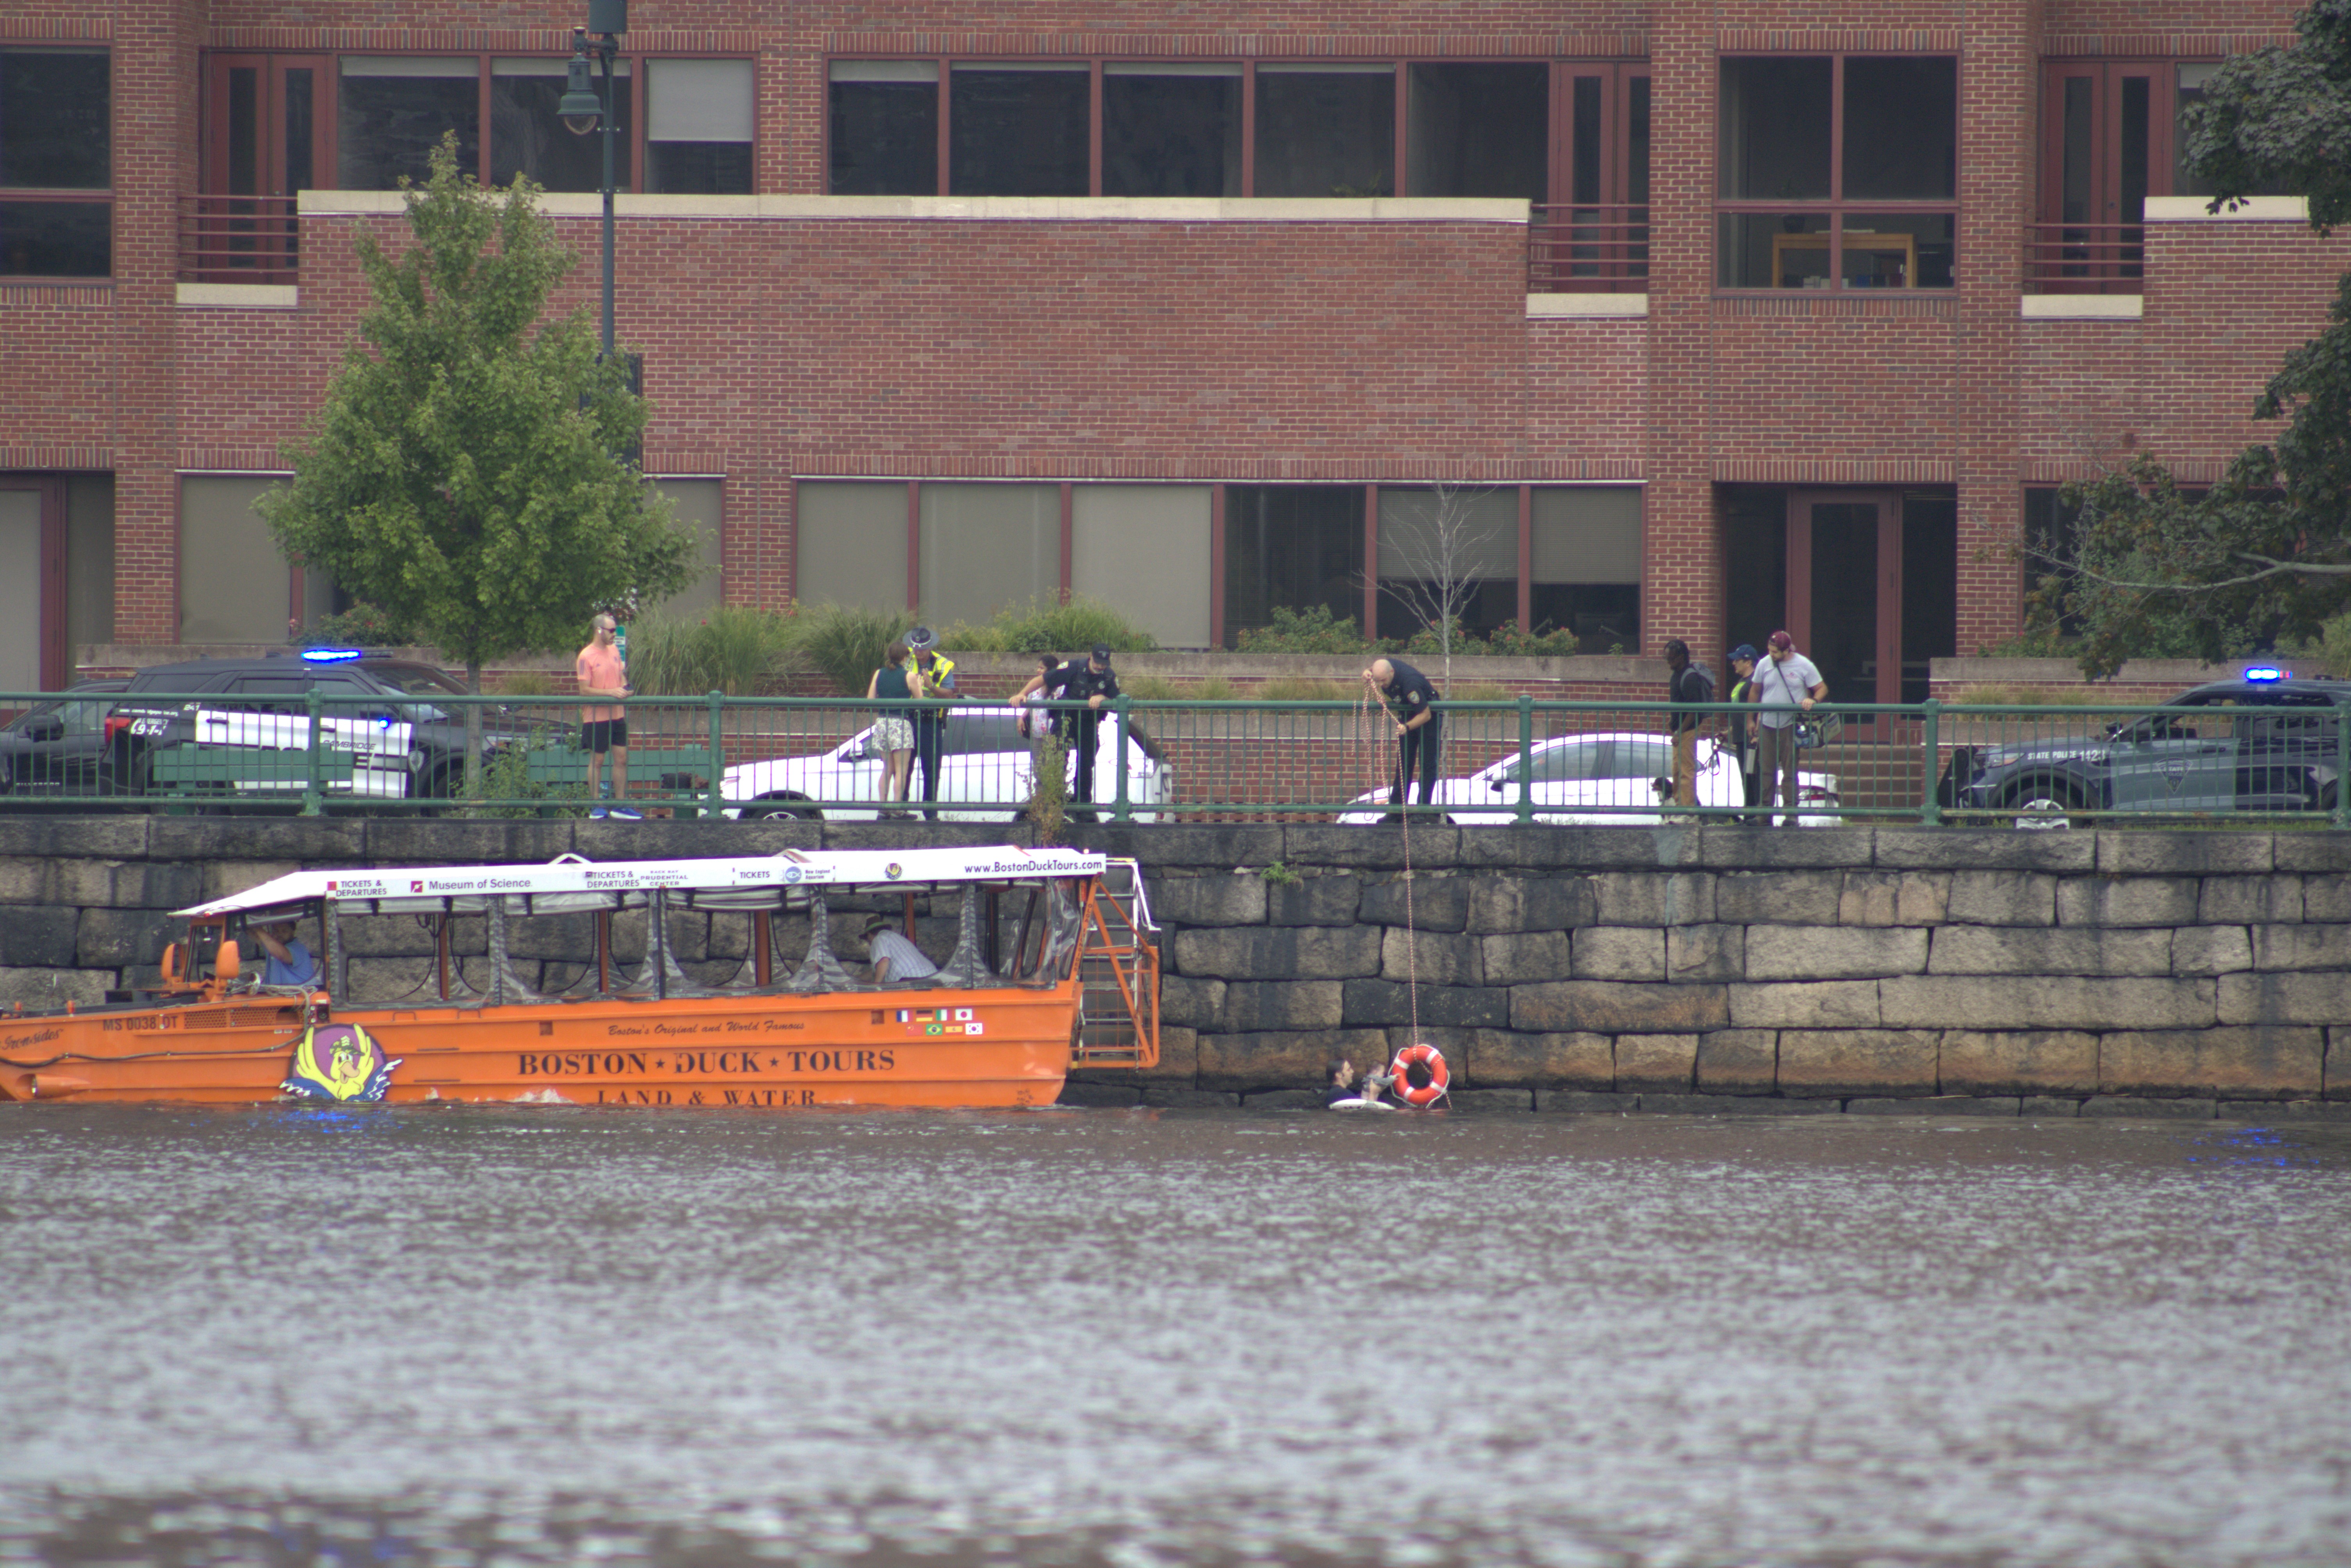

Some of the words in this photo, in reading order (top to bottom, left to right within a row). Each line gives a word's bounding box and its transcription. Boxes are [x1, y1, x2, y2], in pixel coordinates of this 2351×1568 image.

[2028, 751, 2050, 760] STATE
[965, 860, 1102, 872] www.BostonDuckTours.com
[430, 881, 473, 890] Museum
[478, 879, 487, 888] of
[587, 880, 640, 888] DEPARTURES
[336, 888, 387, 897] DEPARTURES
[103, 1019, 122, 1031] MS
[127, 1017, 157, 1030] 0038
[162, 1015, 178, 1029] DT
[608, 1024, 649, 1035] Boston's
[654, 1023, 698, 1036] Original
[701, 1024, 722, 1033] and
[726, 1021, 760, 1031] World
[763, 1020, 804, 1033] Famous
[518, 1053, 648, 1075] BOSTON
[673, 1052, 762, 1074] DUCK
[788, 1050, 894, 1072] TOURS
[598, 1090, 672, 1105] LAND
[689, 1090, 705, 1105] &
[723, 1090, 815, 1106] WATER
